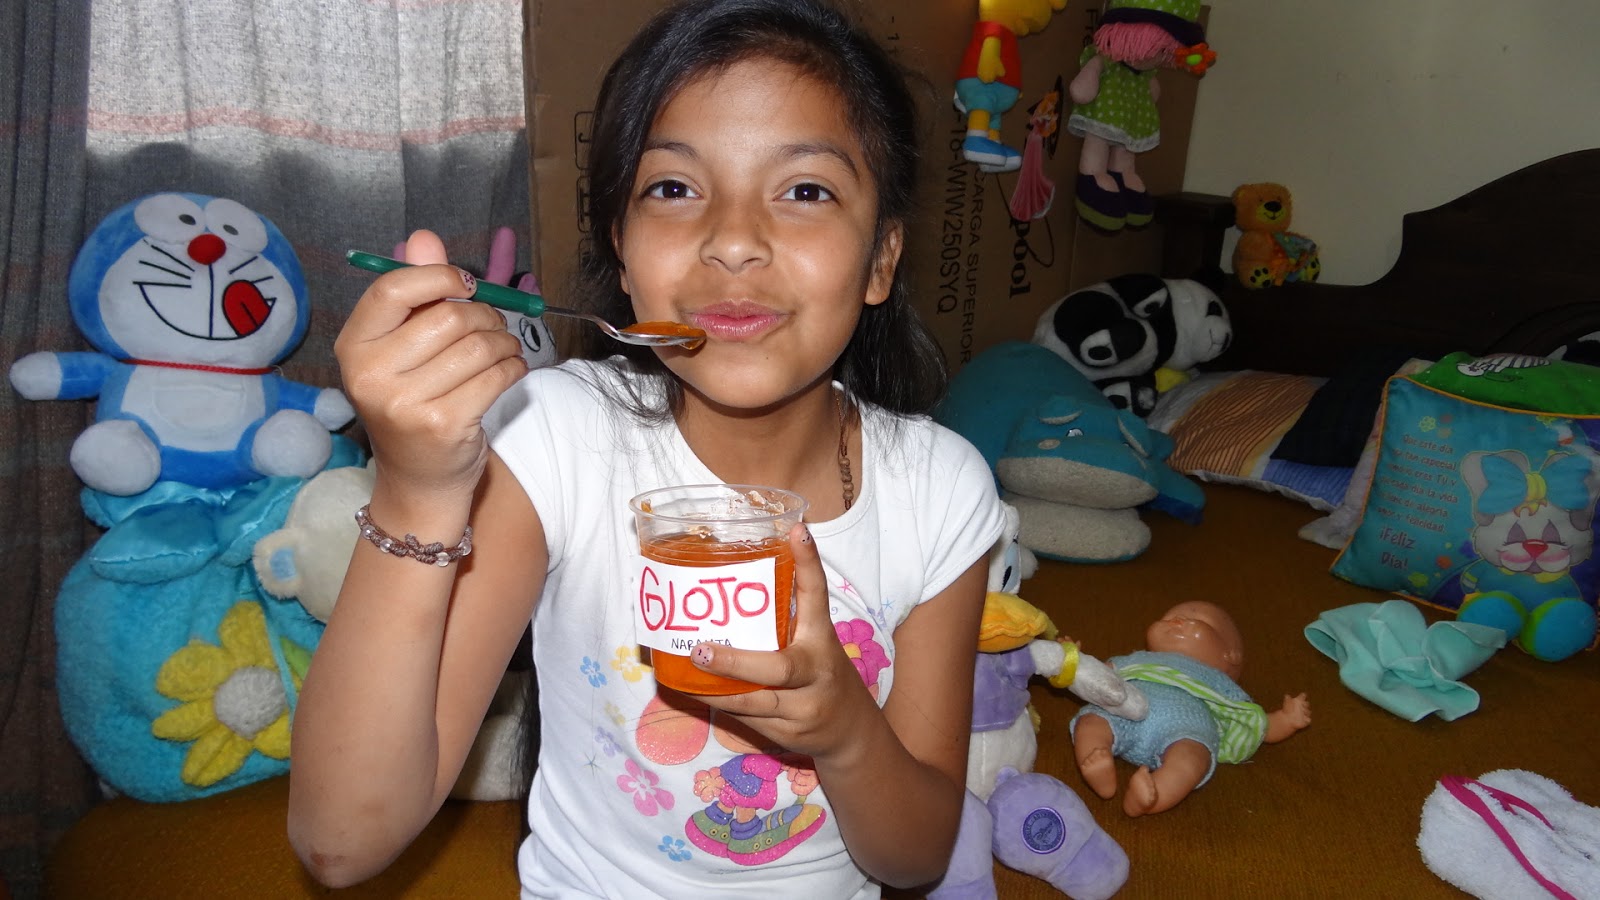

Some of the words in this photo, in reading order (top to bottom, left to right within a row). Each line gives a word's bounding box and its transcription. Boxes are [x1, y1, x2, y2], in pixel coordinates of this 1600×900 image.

[968, 171, 986, 248] CARGA
[960, 253, 979, 365] SUPERIOR
[639, 565, 770, 632] GLOJO
